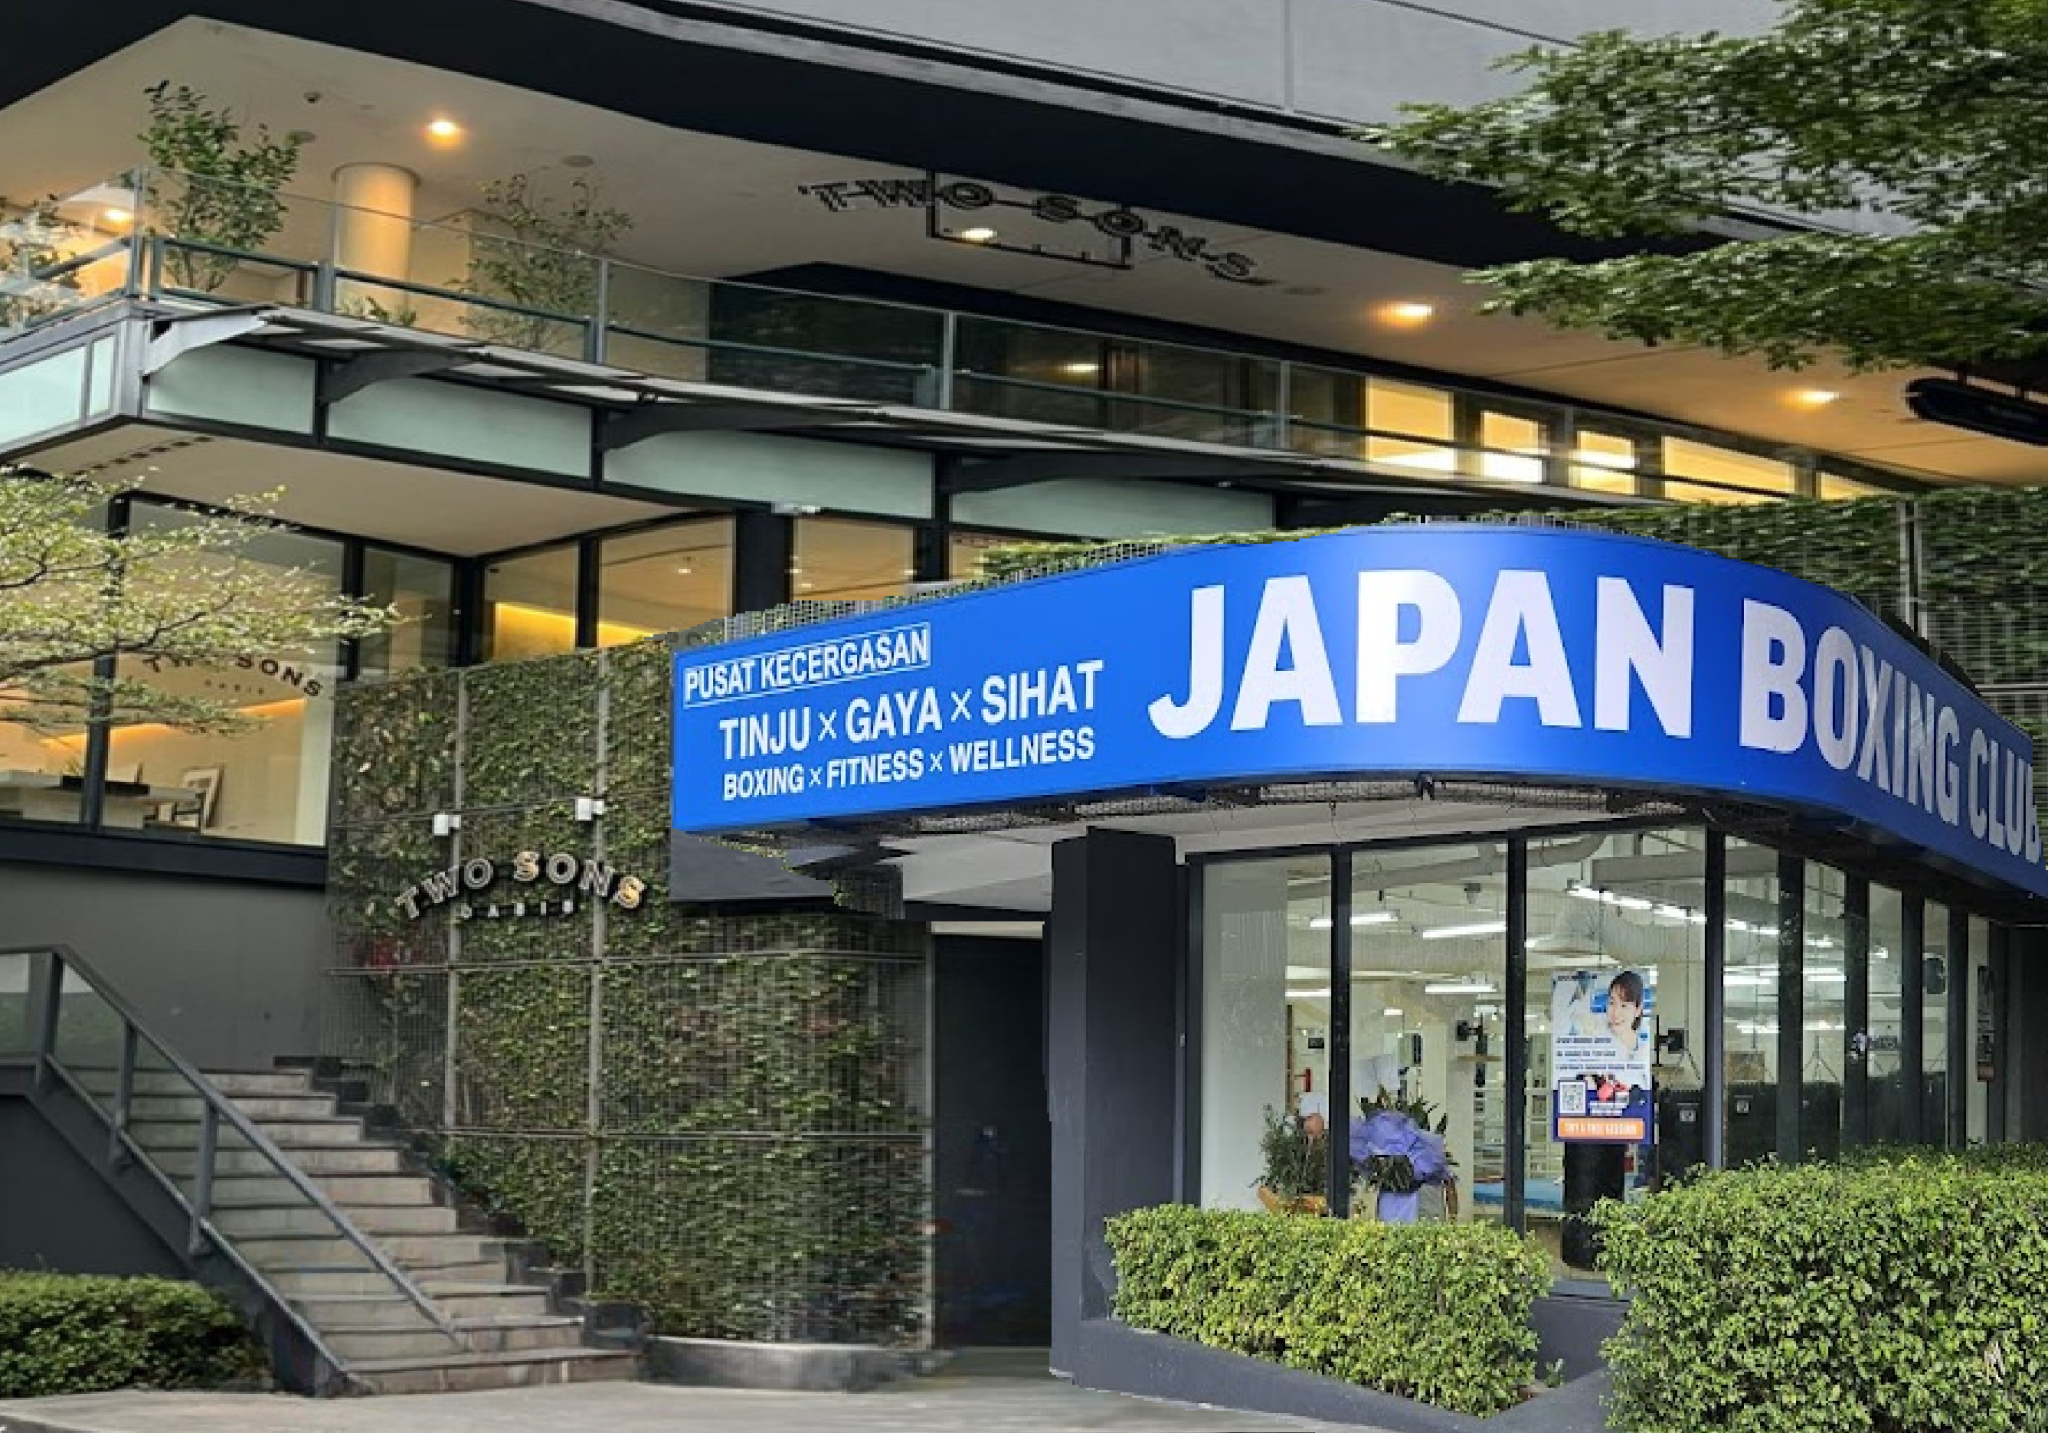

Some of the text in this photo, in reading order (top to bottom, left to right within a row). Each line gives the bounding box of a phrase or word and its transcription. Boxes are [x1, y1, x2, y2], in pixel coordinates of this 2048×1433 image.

[236, 656, 323, 696] SONS
[685, 629, 929, 700] PUSAT KECERGASAN
[719, 706, 810, 759] TINJU
[845, 687, 942, 743] GAYA
[981, 660, 1104, 726] SIHAT
[1147, 569, 2040, 864] JAPAN BOXING CLUB
[723, 763, 805, 801] BOXING
[827, 748, 924, 788] FITNESS
[949, 727, 1095, 774] WELLNESS
[394, 850, 646, 919] TWO SONS
